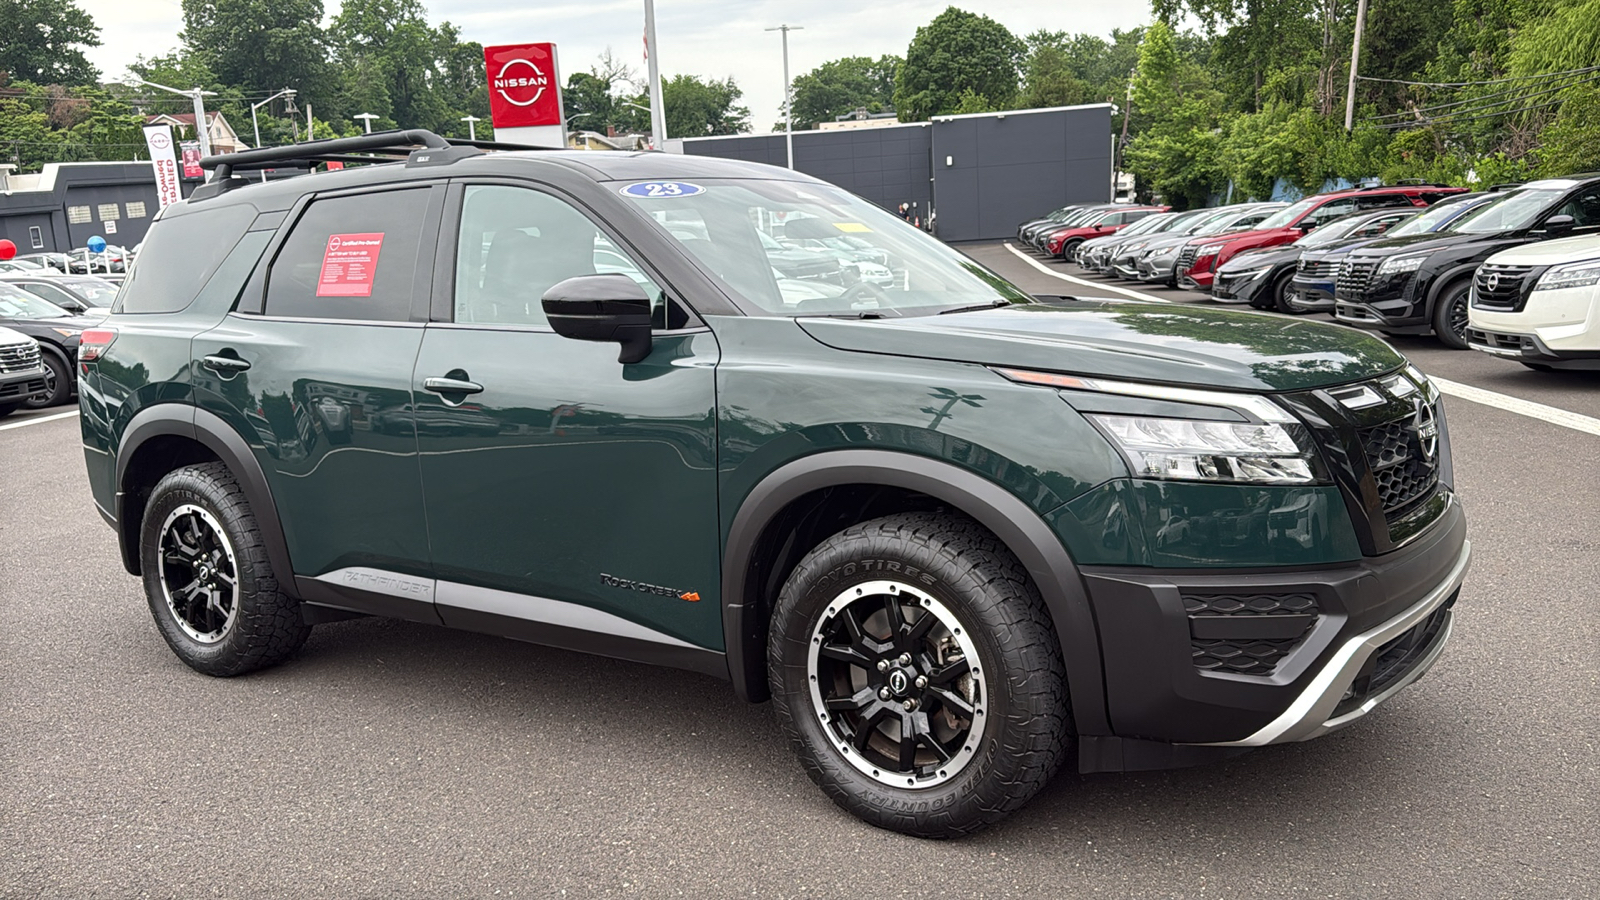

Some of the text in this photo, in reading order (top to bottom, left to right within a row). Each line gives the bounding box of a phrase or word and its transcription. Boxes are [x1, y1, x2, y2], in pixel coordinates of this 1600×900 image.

[494, 76, 547, 88] NISSAN
[645, 183, 682, 196] 23
[1419, 427, 1436, 439] NISS
[343, 570, 431, 595] PATHFINDER
[860, 559, 938, 586] TIRES
[600, 572, 683, 599] ROCK CREEK
[962, 737, 999, 796] OPEN
[856, 790, 958, 814] COUNTRY
